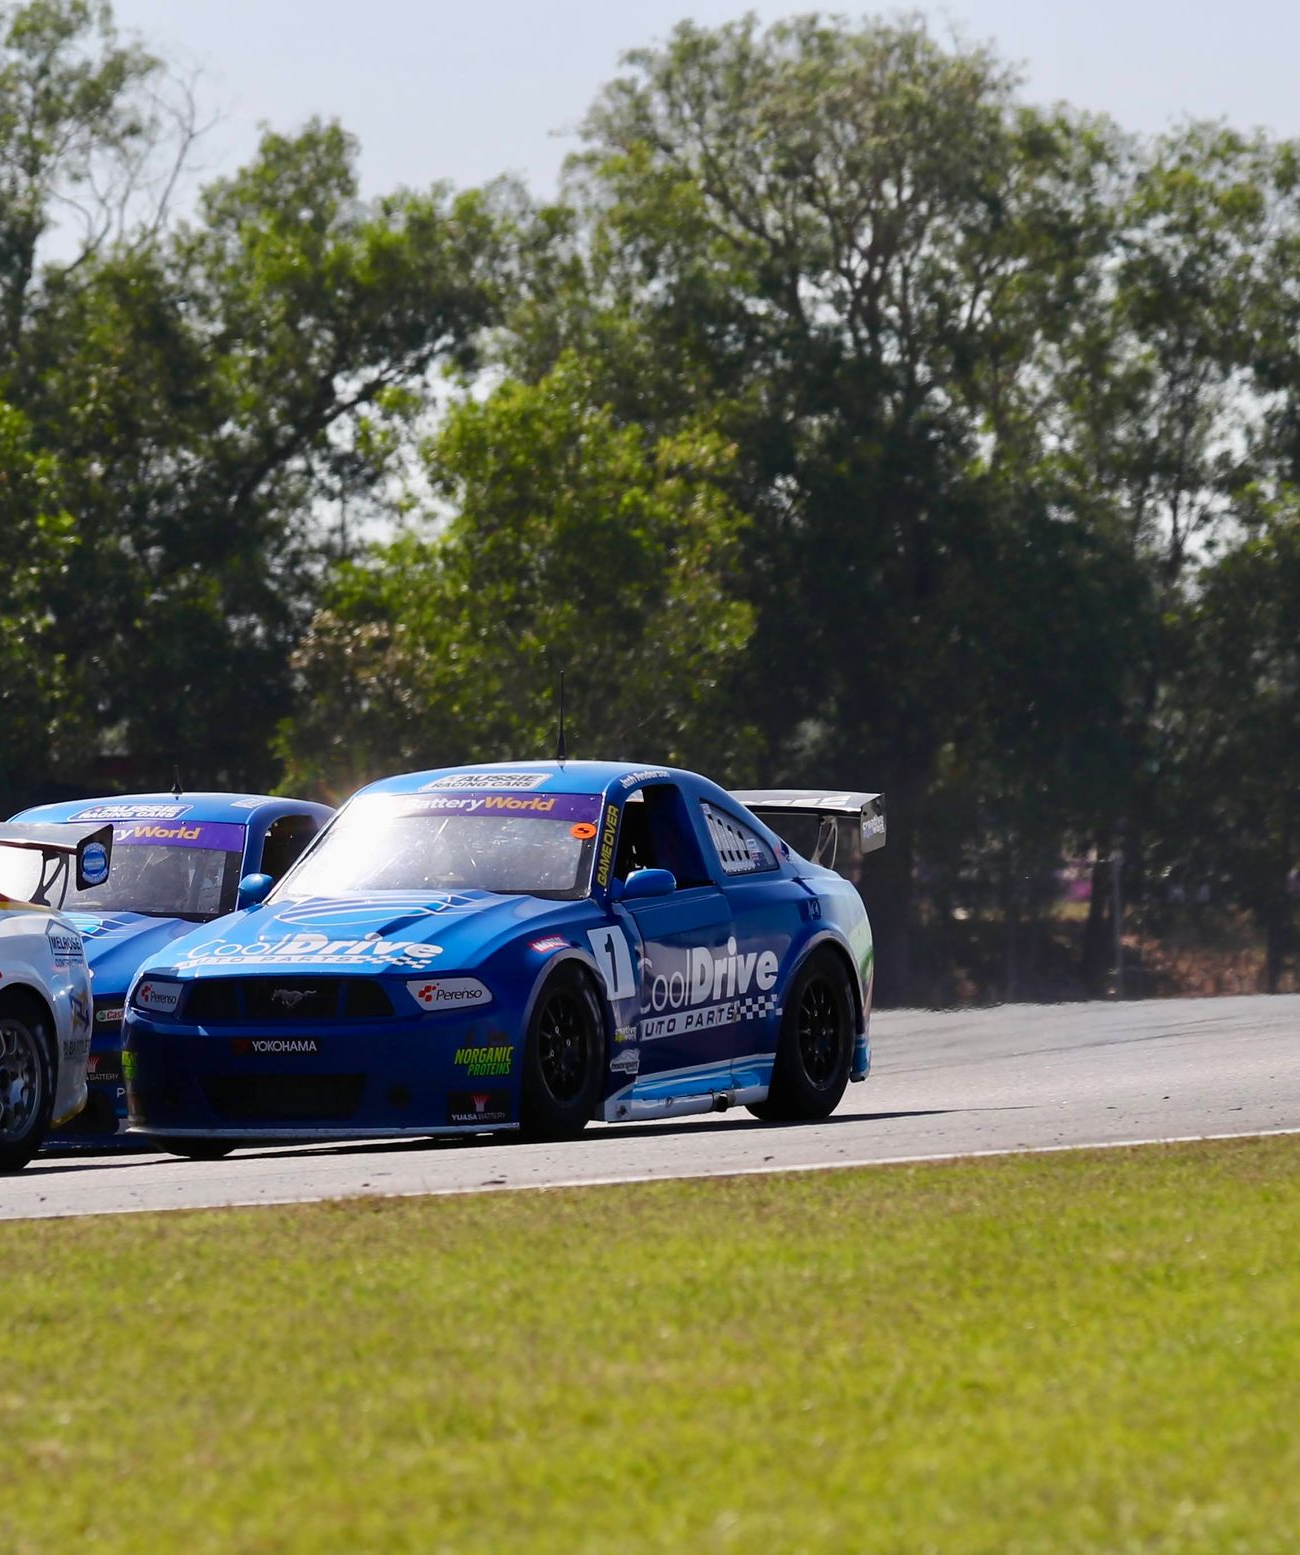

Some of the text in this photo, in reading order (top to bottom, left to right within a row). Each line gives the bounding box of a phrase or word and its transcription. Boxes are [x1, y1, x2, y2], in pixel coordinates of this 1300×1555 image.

[104, 804, 186, 813] AUSSIE
[78, 811, 134, 819] RACING
[51, 935, 82, 950] MELROSE
[261, 955, 356, 963] PARTS
[604, 933, 618, 993] 1
[150, 990, 177, 1004] Perenso
[436, 989, 483, 1001] Perenso
[106, 1011, 123, 1020] Cas
[251, 1039, 317, 1052] YOKOHAMA
[454, 1046, 515, 1065] NORGANIC
[467, 1062, 512, 1076] PROTEINS
[90, 1073, 120, 1081] BATTERY
[452, 1112, 478, 1121] YUASA
